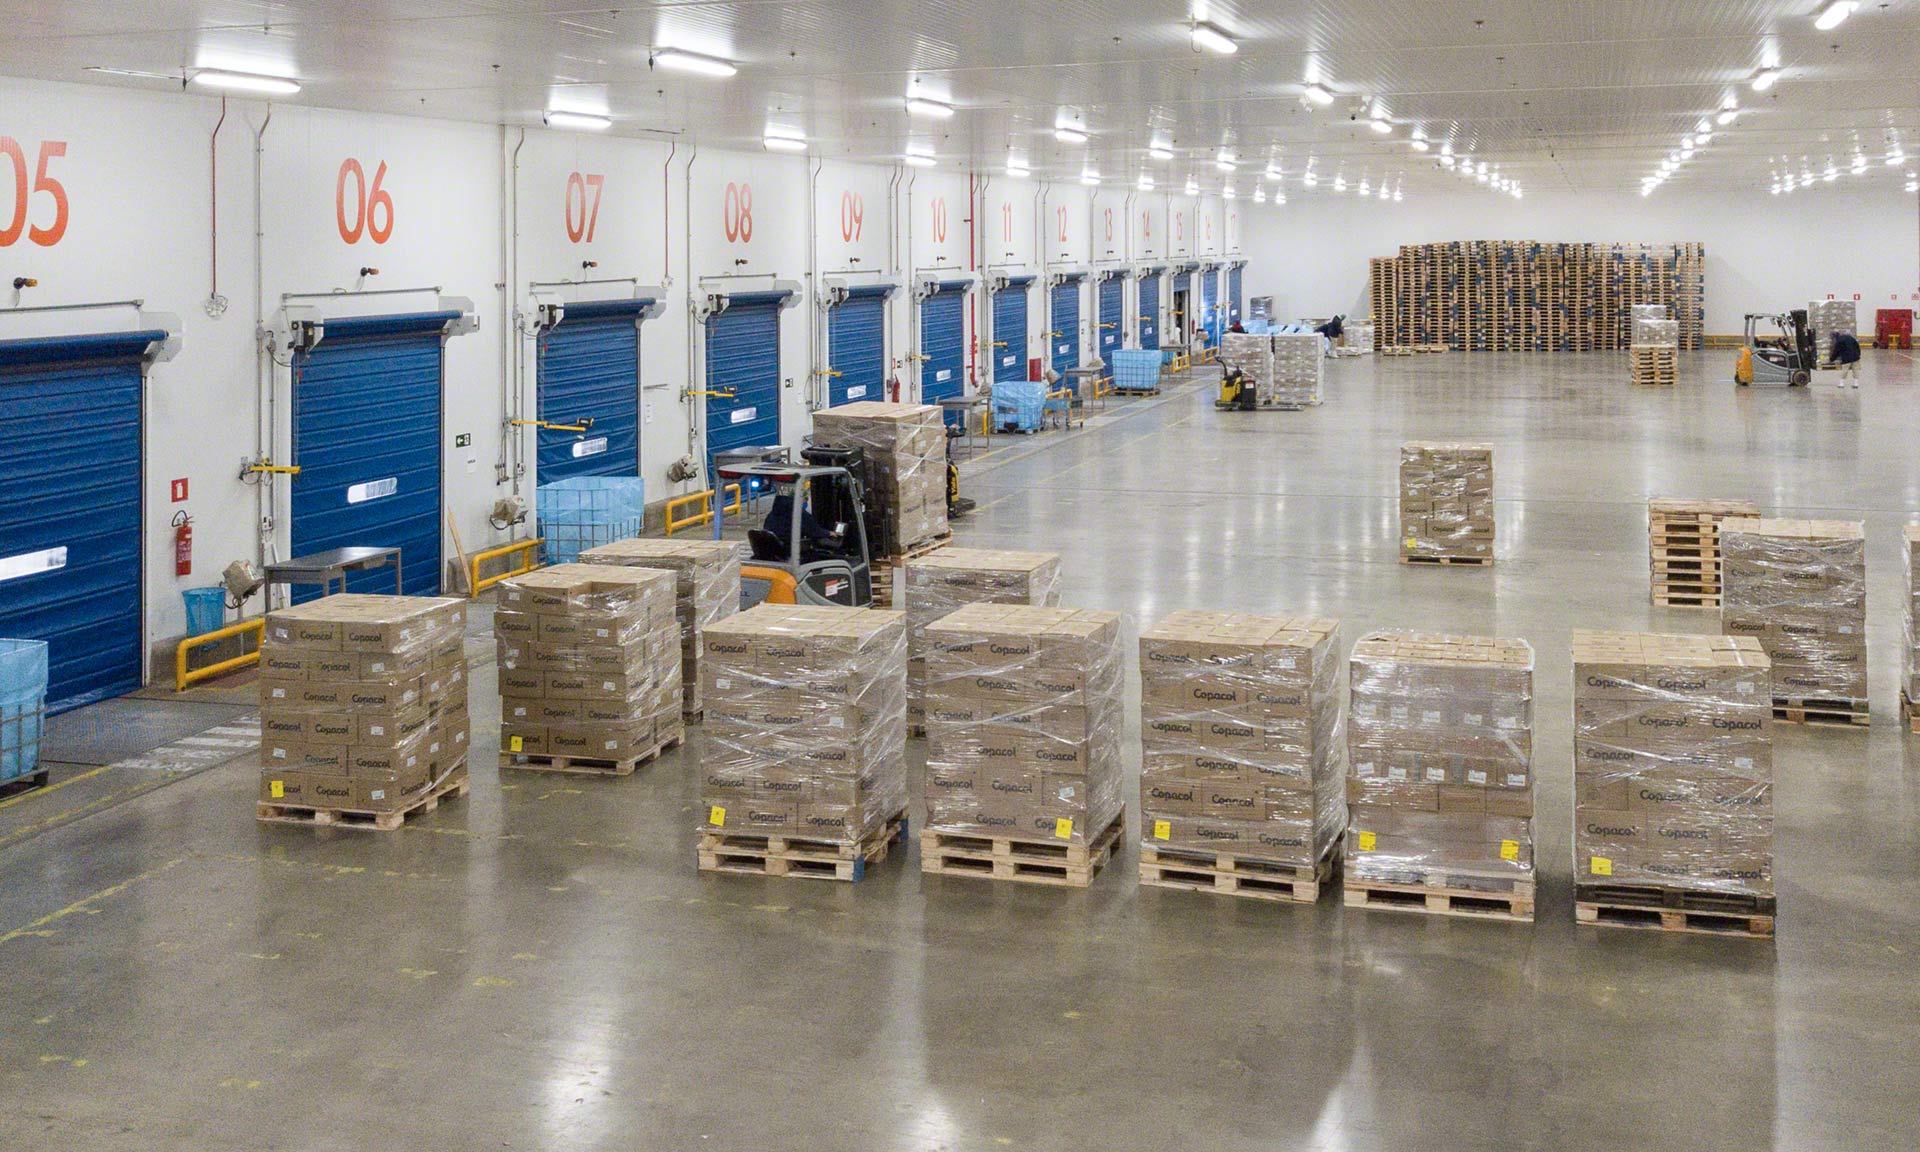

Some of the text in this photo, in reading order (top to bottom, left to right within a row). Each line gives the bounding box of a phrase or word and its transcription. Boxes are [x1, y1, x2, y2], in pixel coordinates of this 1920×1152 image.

[0, 136, 69, 247] 05
[336, 157, 394, 245] 06
[565, 172, 604, 243] 07
[724, 182, 752, 243] 08
[842, 190, 863, 242] 09
[931, 197, 946, 243] 10
[1003, 202, 1011, 242] 11
[1057, 205, 1067, 242] 12
[1104, 208, 1113, 242] 13
[1142, 208, 1150, 242] 14
[501, 621, 532, 632] Copacol
[544, 624, 576, 633] Copacol
[1730, 621, 1766, 631] Copacol
[1781, 624, 1818, 634] Copacol
[300, 630, 333, 640] Copacol
[349, 632, 382, 642] Copacol
[708, 641, 747, 653] Copacol
[766, 646, 805, 658] Copacol
[934, 641, 973, 653] Copacol
[990, 643, 1030, 655] Copacol
[536, 652, 568, 662] Copacol
[586, 655, 618, 664] Copacol
[267, 658, 300, 669] Copacol
[319, 661, 350, 671] opacol
[506, 678, 537, 688] Copacol
[551, 680, 584, 690] Copacol
[976, 678, 1017, 691] Copacol
[1657, 678, 1706, 690] Copacol
[1783, 676, 1820, 687] Copacol
[303, 692, 337, 702] Copacol
[351, 694, 386, 704] Copacol
[1193, 688, 1236, 701] Copacol
[1256, 692, 1301, 705] Copacol
[543, 707, 575, 717] Copacol
[588, 710, 620, 719] Copacol
[763, 713, 802, 725] Copacol
[1638, 715, 1688, 728] Copacol
[1712, 718, 1762, 731] Copacol
[267, 720, 301, 732] Copacol
[314, 724, 349, 734] Copacol
[1211, 724, 1254, 738] Copacol
[554, 736, 586, 746] Copacol
[976, 744, 1017, 757] Copacol
[1036, 750, 1077, 762] Copacol
[1585, 748, 1635, 761] Copacol
[304, 754, 338, 765] Copacol
[356, 758, 390, 768] Copacol
[1195, 757, 1238, 771] Copacol
[707, 775, 745, 787] Copacol
[762, 780, 802, 791] Copacol
[933, 776, 973, 788] Copacol
[991, 780, 1033, 793] Copacol
[316, 785, 349, 796] Copacol
[1151, 787, 1193, 801] Copacol
[1211, 793, 1255, 808] Copacol
[748, 810, 788, 823] Copacol
[805, 816, 845, 827] Copacol
[976, 814, 1017, 826] Copacol
[1196, 827, 1239, 840] Copacol
[1587, 823, 1636, 836] Copacol
[1658, 826, 1709, 839] Copacol
[1258, 833, 1303, 847] Copacol
